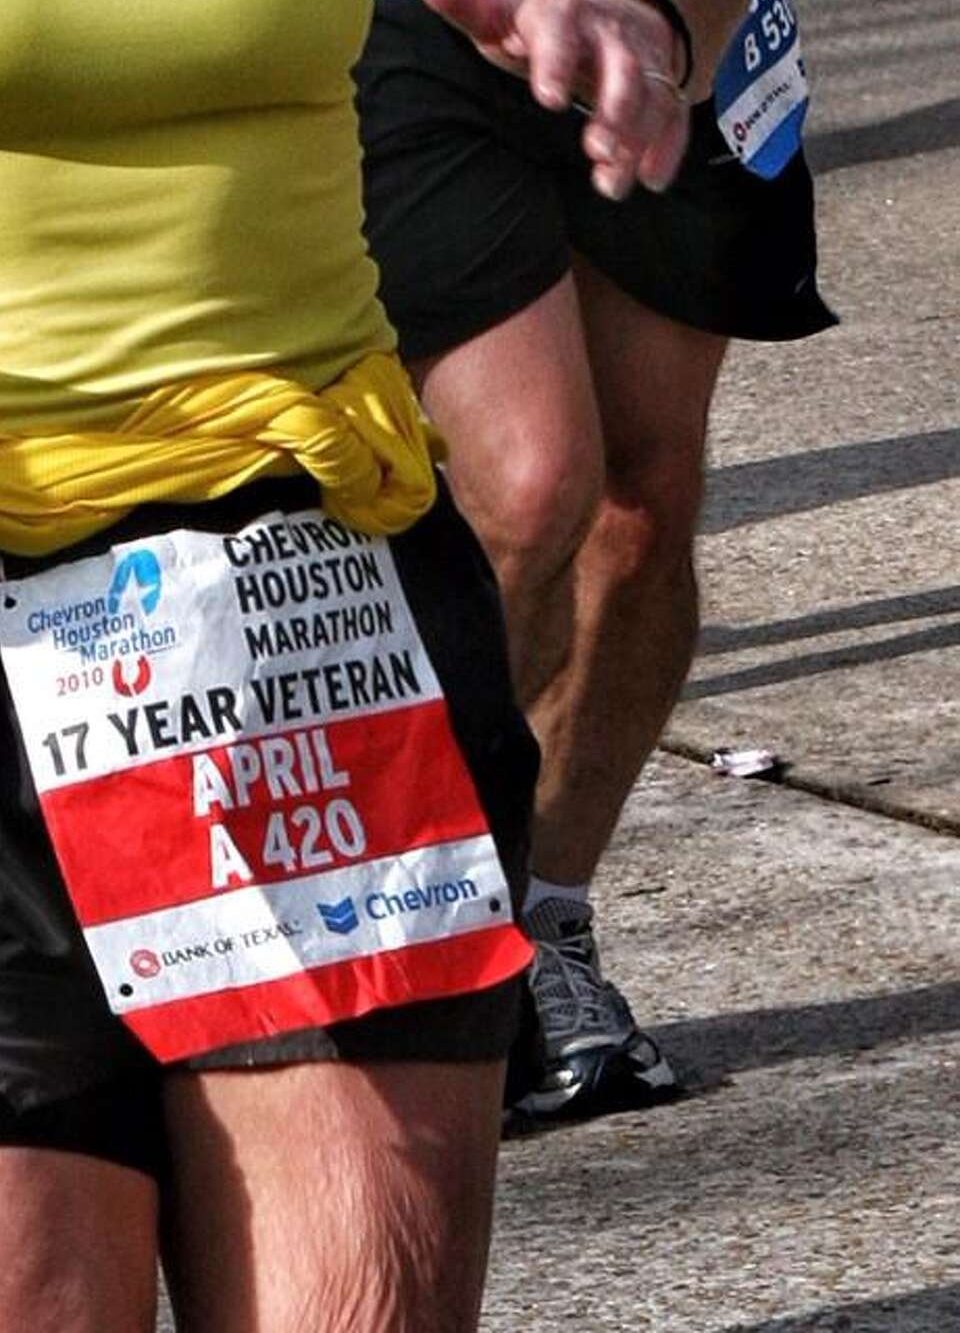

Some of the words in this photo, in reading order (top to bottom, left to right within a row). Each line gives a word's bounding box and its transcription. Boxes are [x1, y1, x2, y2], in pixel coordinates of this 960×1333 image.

[744, 32, 762, 72] B
[235, 551, 384, 614] HOUSTON
[28, 597, 106, 634] Chevron
[53, 613, 134, 650] Houston
[244, 600, 393, 660] MARATHON
[80, 625, 176, 665] Marathon
[57, 666, 104, 696] 2010
[42, 722, 90, 777] 17
[107, 686, 243, 756] YEAR
[250, 649, 421, 725] VETERAN
[192, 728, 351, 818] APRIL
[209, 823, 254, 889] A
[262, 798, 368, 873] 420
[365, 876, 479, 921] Chevron
[162, 941, 214, 967] BANK
[213, 936, 234, 954] OF
